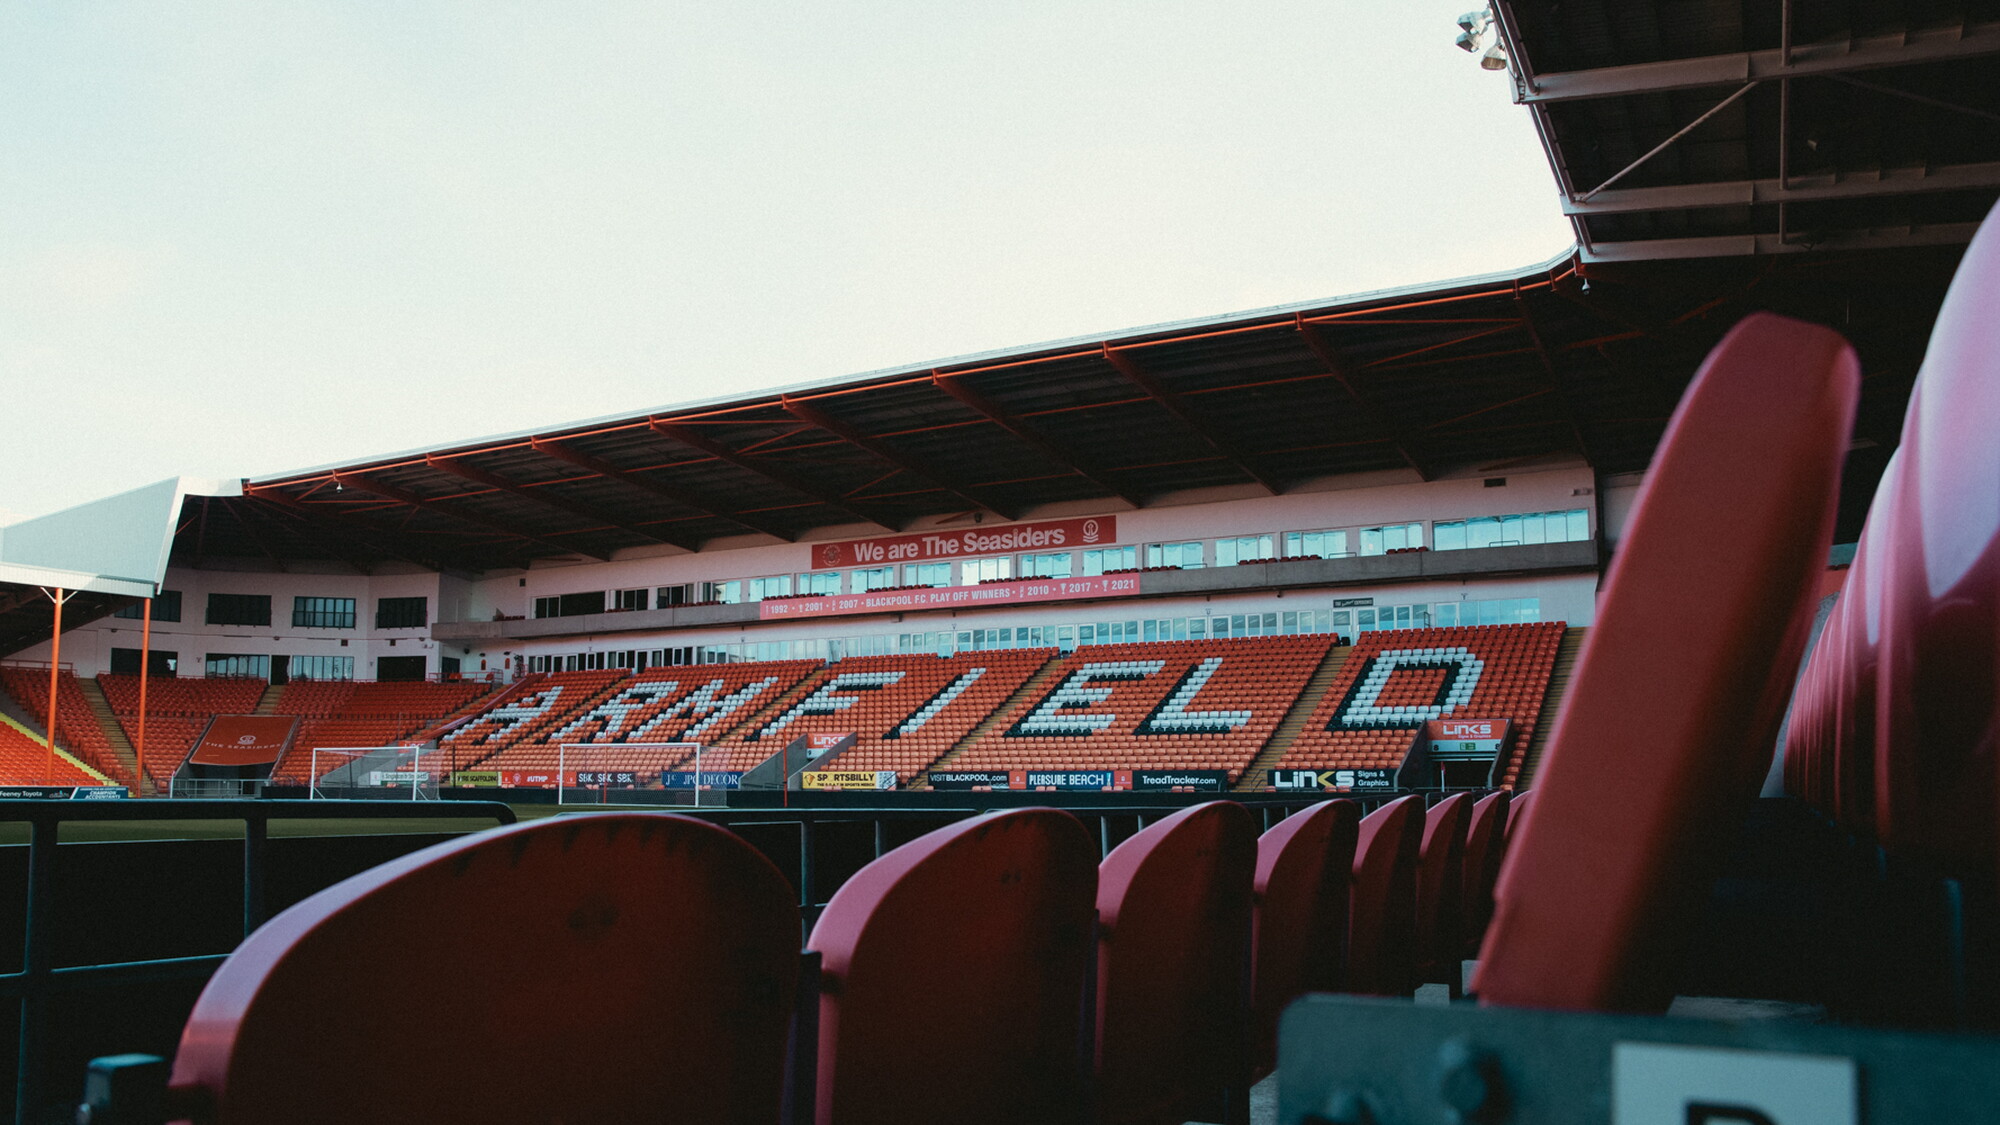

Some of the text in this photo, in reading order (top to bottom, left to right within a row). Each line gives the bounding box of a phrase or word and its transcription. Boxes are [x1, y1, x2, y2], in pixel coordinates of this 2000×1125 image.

[854, 542, 884, 562] We
[888, 543, 919, 560] are
[922, 536, 959, 556] The
[963, 527, 1065, 552] Seasiders
[771, 604, 788, 614] 1992
[839, 600, 858, 610] 2007
[866, 596, 912, 608] BLACKPOOL
[930, 591, 950, 603] PLAY
[953, 590, 969, 601] OFF
[971, 588, 1010, 601] WINNERS
[1027, 585, 1049, 596] 2010
[1069, 582, 1091, 593] 2017
[1111, 579, 1134, 591] 2021
[703, 774, 739, 785] DECOR
[1357, 770, 1378, 779] Signs
[1029, 774, 1104, 786] PLEASURE BEACH
[1142, 775, 1217, 785] TreadTracker.com
[1358, 779, 1390, 787] Graphics
[22, 790, 43, 798] Toyota
